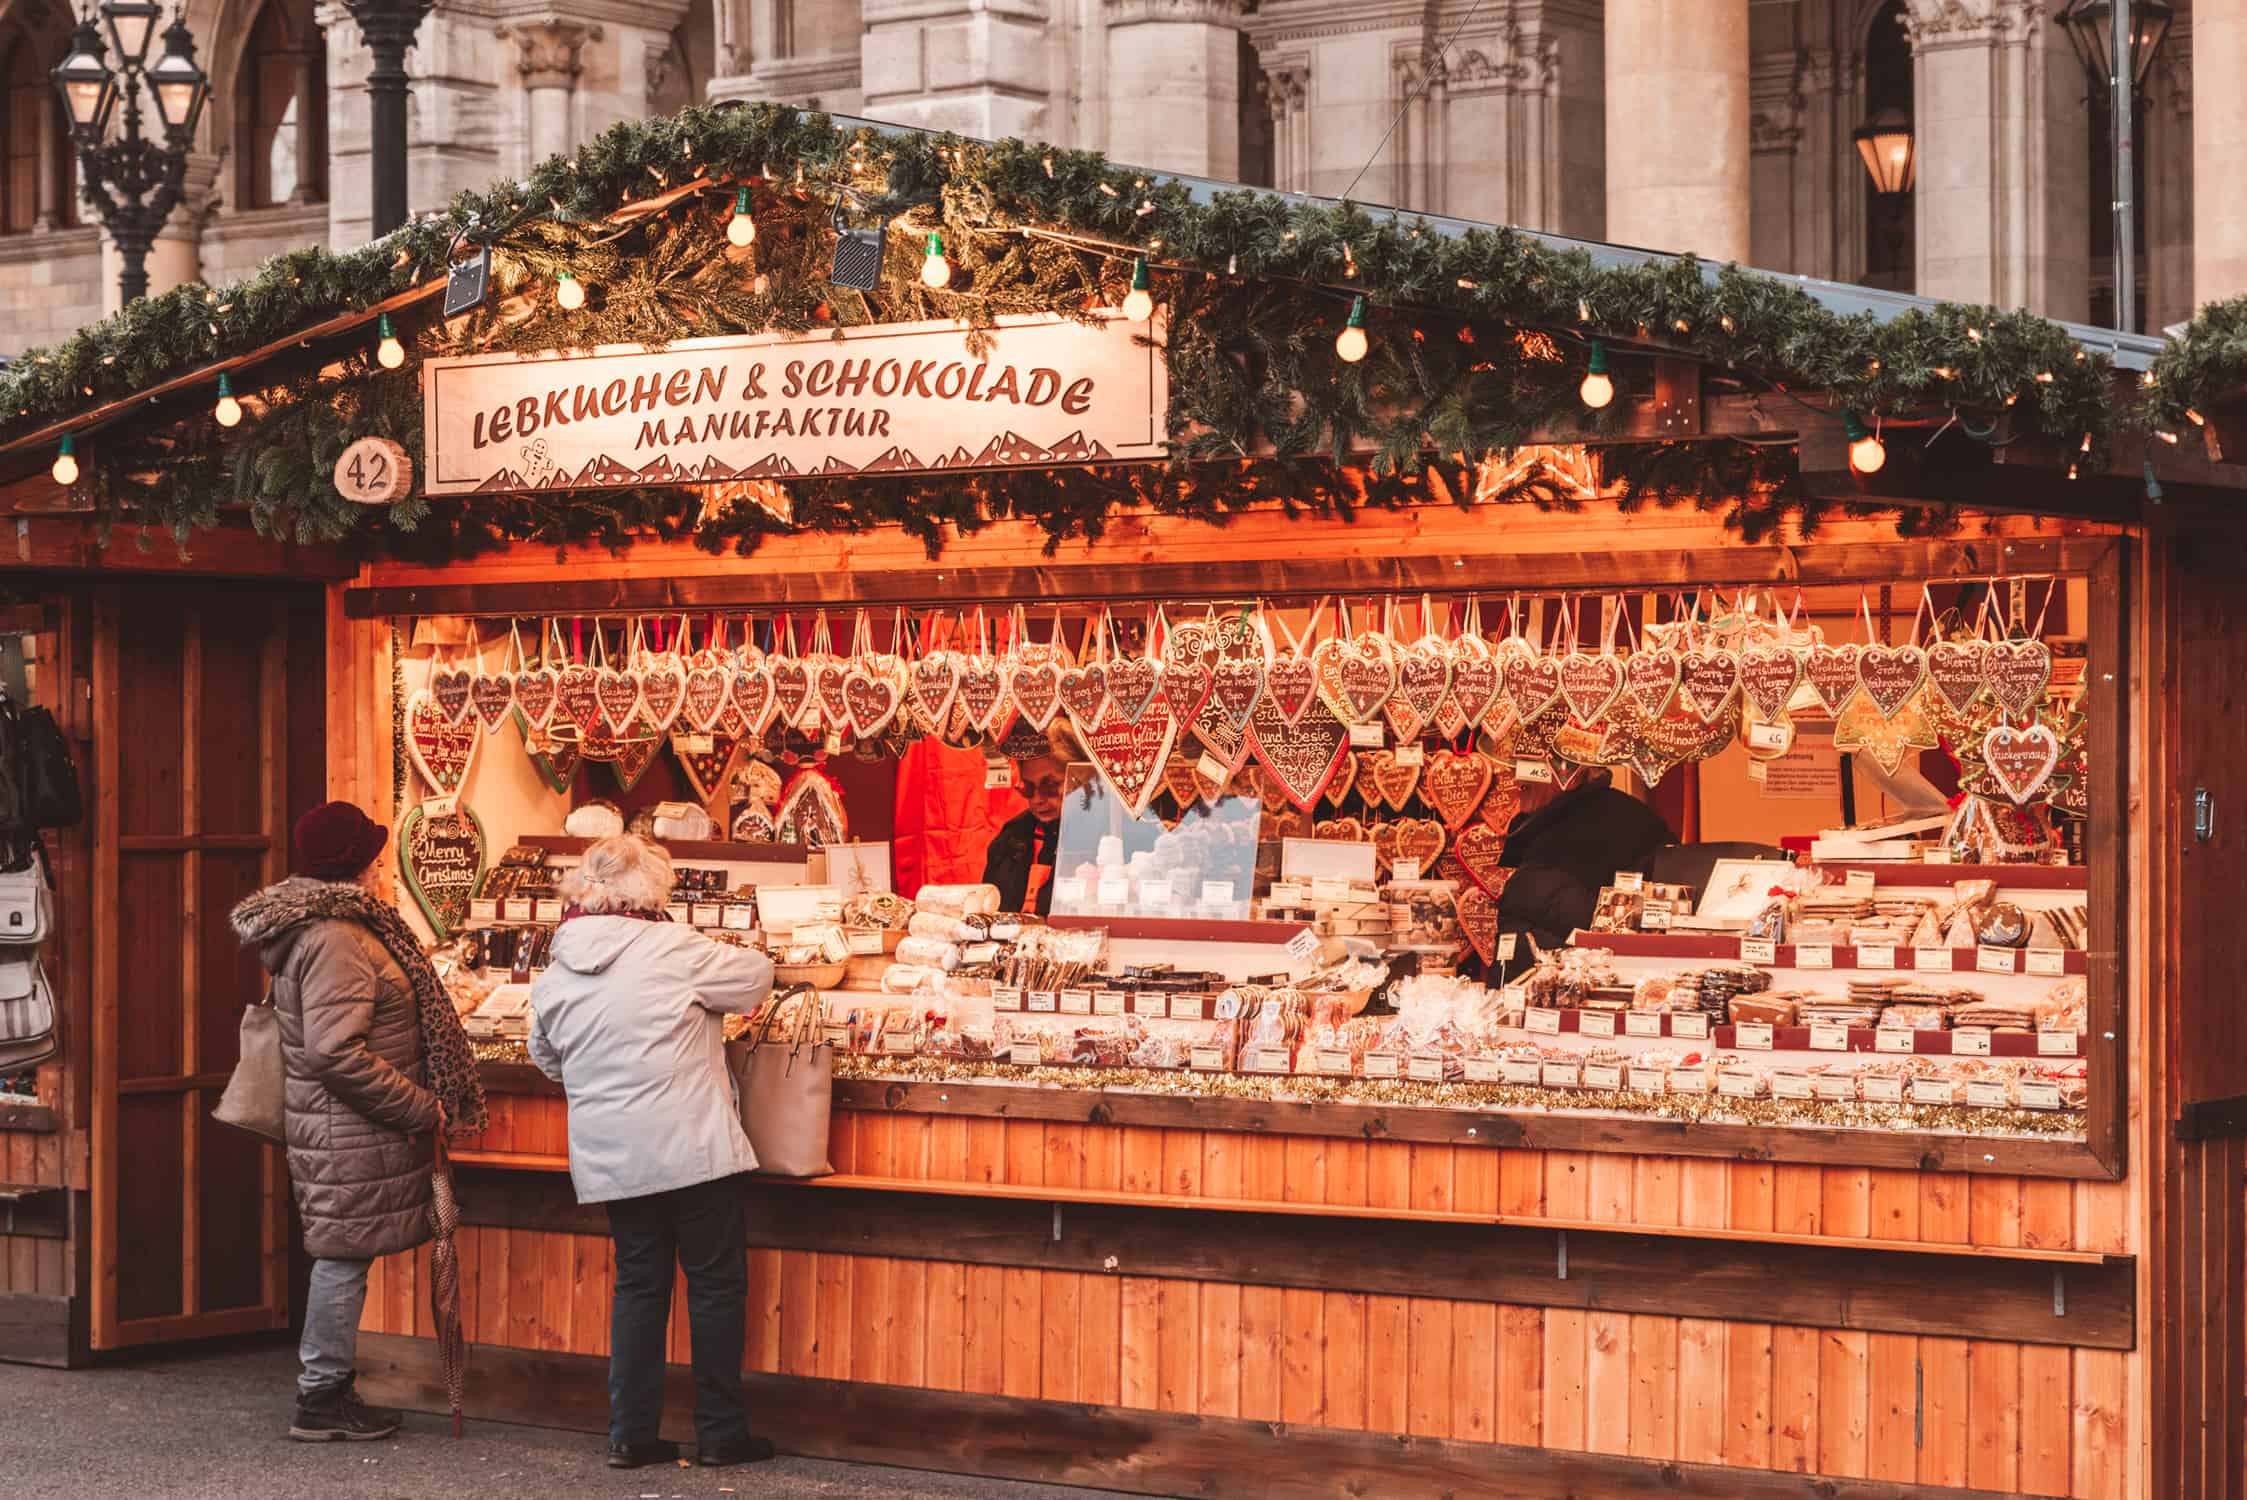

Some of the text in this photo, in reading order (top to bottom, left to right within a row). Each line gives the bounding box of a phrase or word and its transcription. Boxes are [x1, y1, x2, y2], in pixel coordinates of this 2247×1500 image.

[473, 357, 1095, 450] LEBKUCHEN & SCHOKOLADE
[634, 407, 891, 451] MANUFAKTUR
[347, 452, 388, 491] 42
[1088, 730, 1131, 748] meinem
[417, 840, 466, 867] Merry
[419, 865, 474, 885] Christmas
